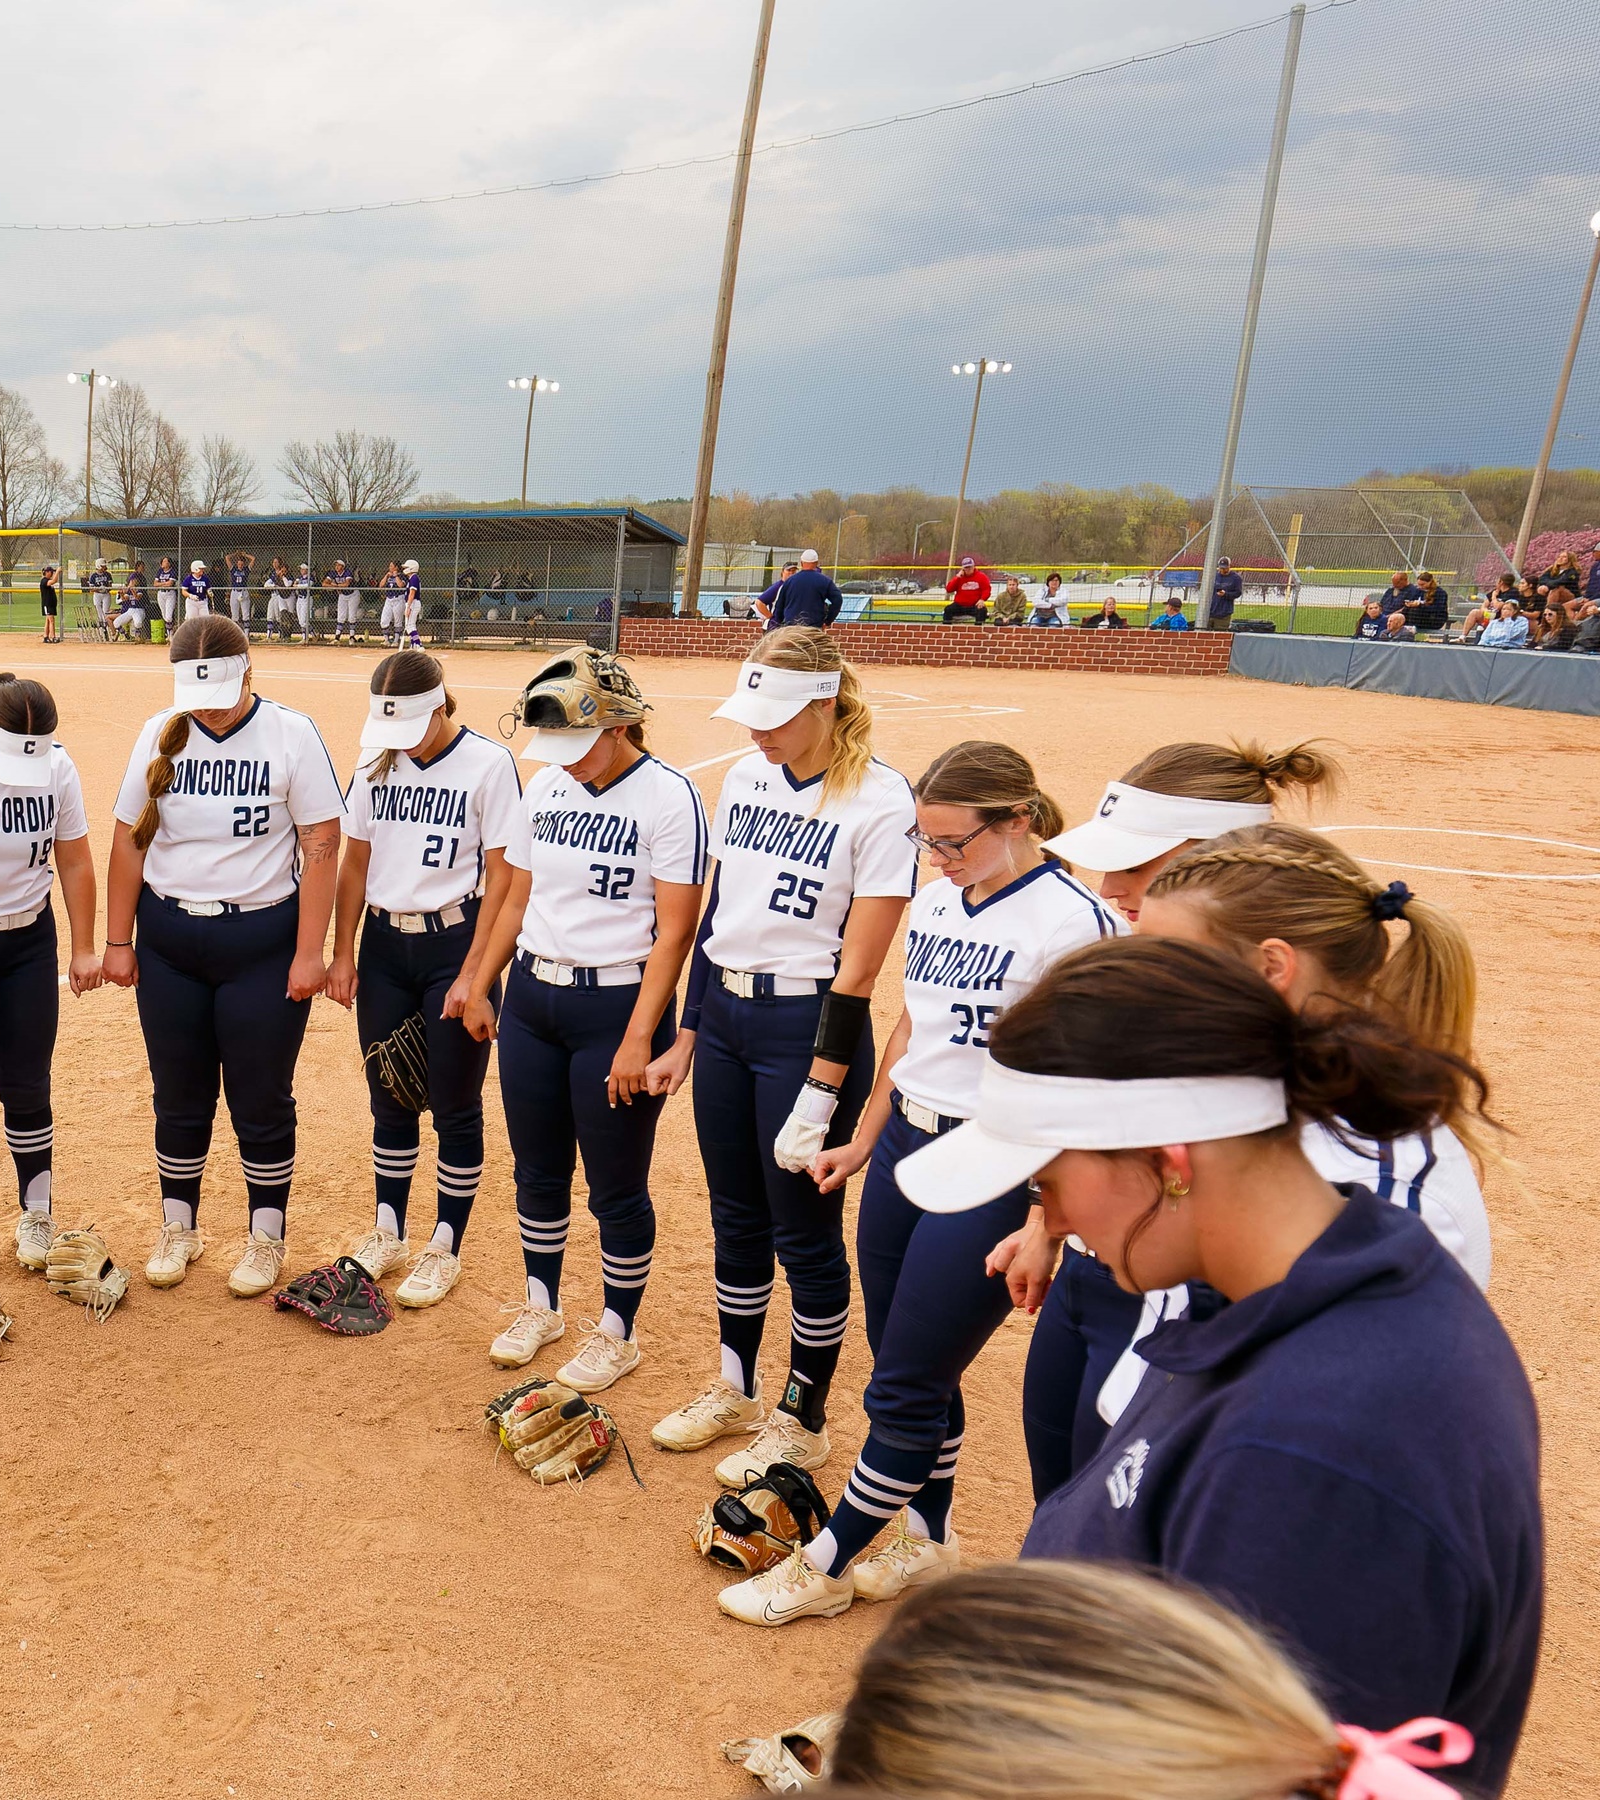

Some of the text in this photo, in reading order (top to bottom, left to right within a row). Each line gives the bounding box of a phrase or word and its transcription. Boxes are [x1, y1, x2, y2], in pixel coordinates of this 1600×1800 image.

[196, 664, 208, 680] C
[747, 671, 762, 689] C
[384, 701, 395, 717] C
[24, 741, 36, 754] C
[164, 758, 270, 796] ONCORDIA
[233, 805, 270, 837] 22
[371, 784, 468, 828] CONCORDIA
[1100, 793, 1119, 818] C
[28, 836, 53, 869] 19
[421, 834, 460, 869] 21
[724, 802, 841, 870] CONCORDIA
[587, 863, 636, 900] 32
[768, 871, 825, 920] 25
